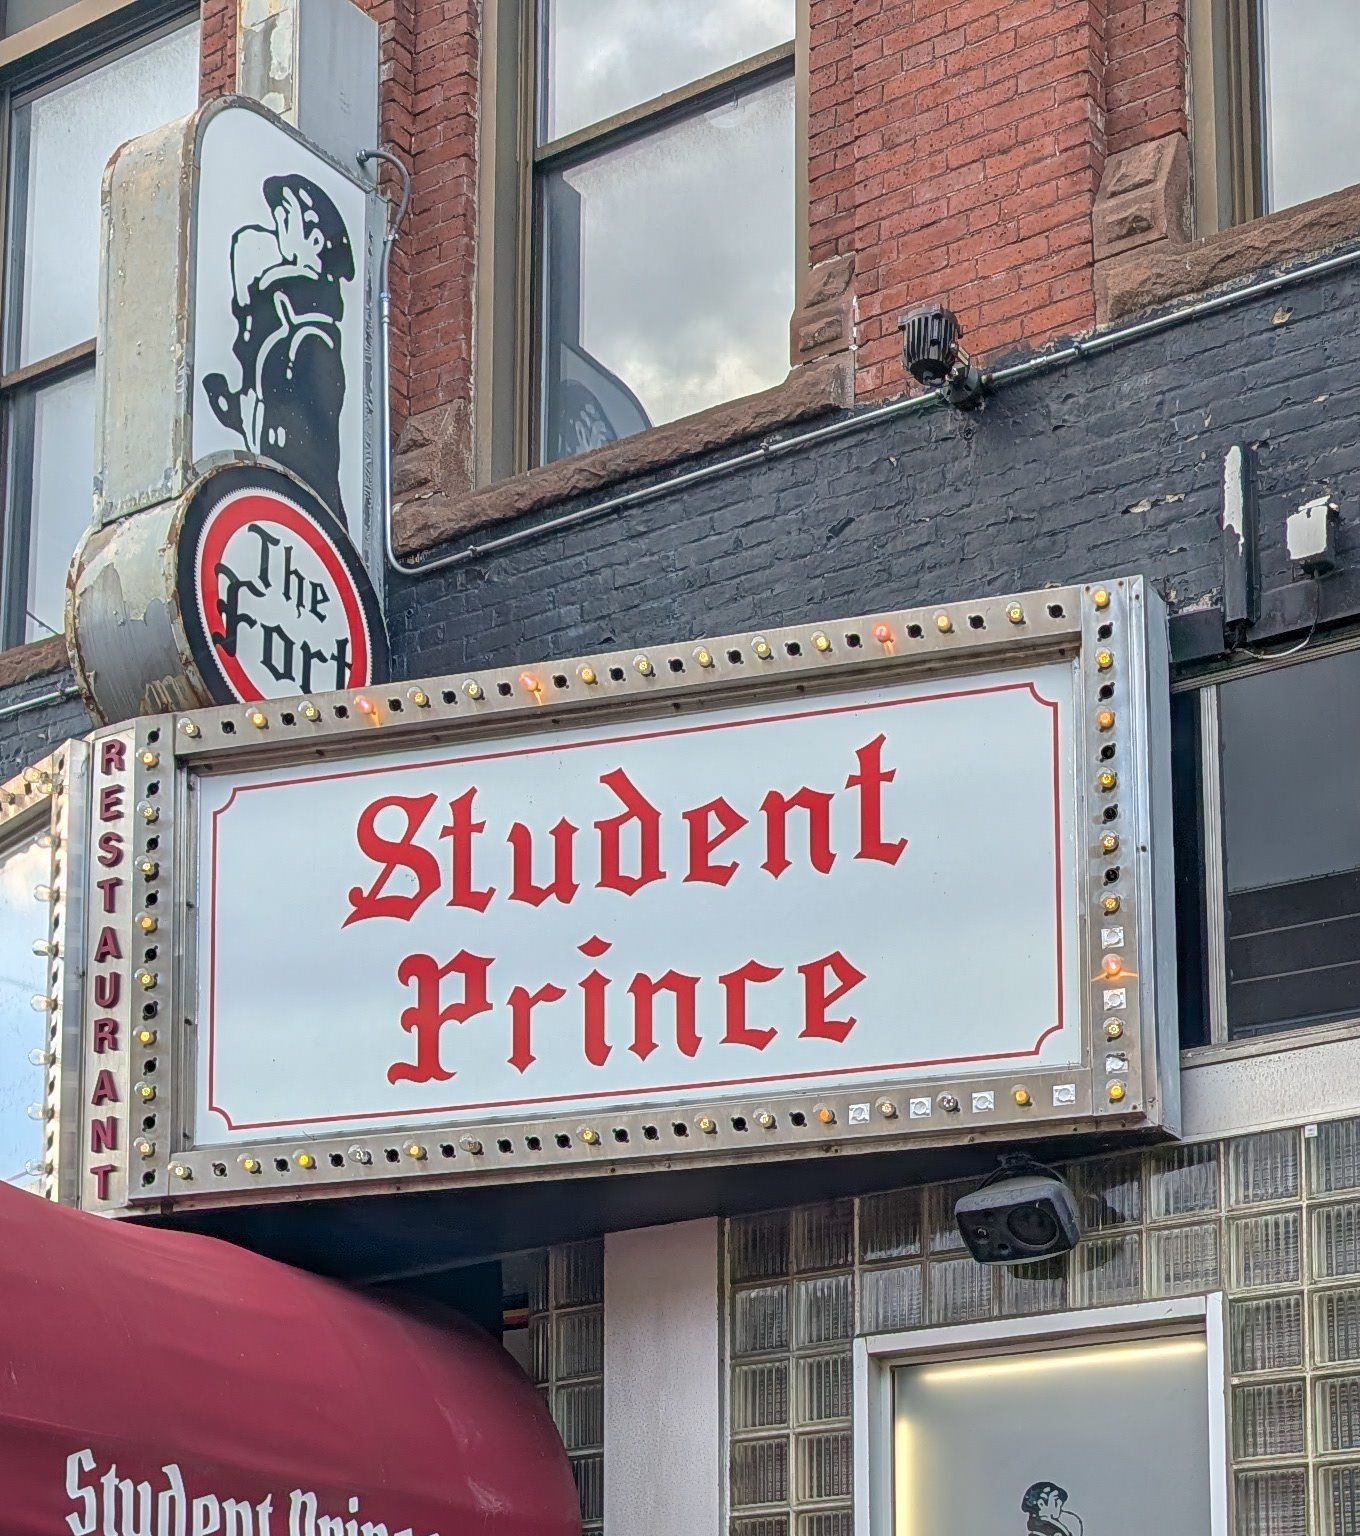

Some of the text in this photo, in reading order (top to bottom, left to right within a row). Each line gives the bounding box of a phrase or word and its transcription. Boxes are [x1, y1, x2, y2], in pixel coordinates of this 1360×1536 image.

[212, 562, 353, 695] Fort
[247, 523, 330, 623] The
[341, 733, 908, 929] Student
[91, 738, 126, 1201] RESTAURANT
[387, 935, 867, 1085] Prince
